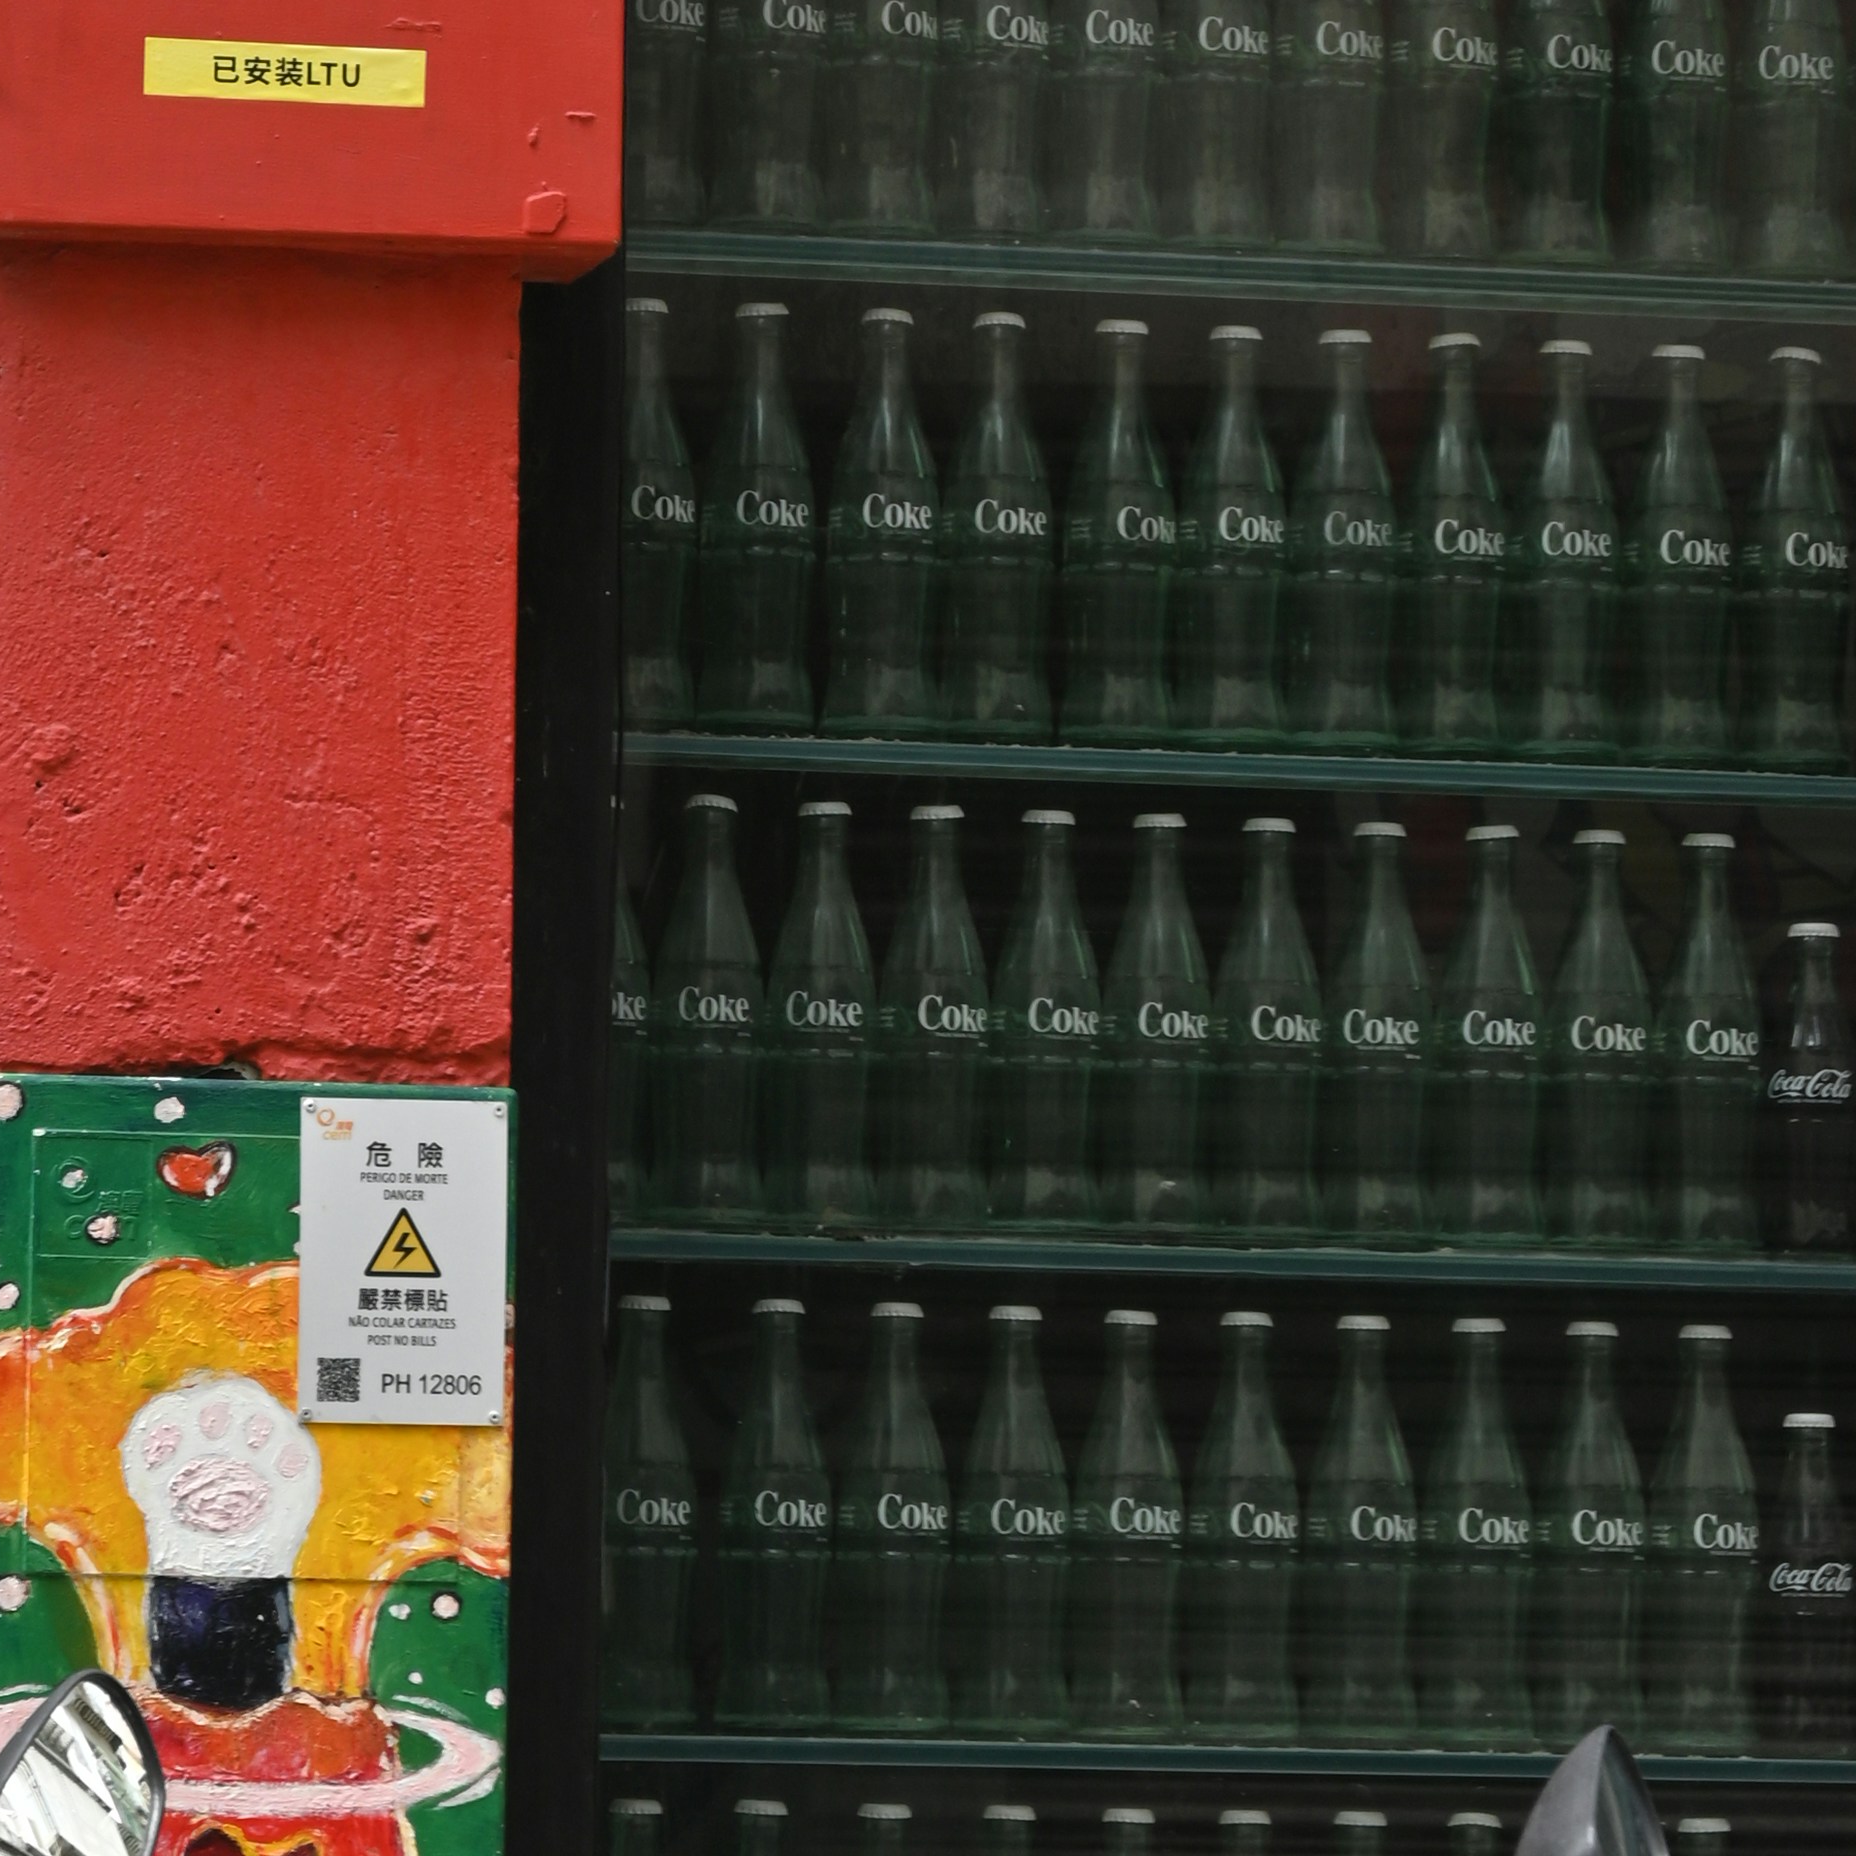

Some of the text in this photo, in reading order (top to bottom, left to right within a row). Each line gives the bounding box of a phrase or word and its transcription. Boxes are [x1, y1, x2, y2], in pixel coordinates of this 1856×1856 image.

[986, 5, 1048, 46] Coke
[1086, 9, 1153, 46] Coke
[1199, 16, 1269, 54] Coke
[1316, 21, 1384, 59] Coke
[213, 56, 361, 87] 已安装LTU
[1652, 40, 1725, 75] Coke
[1758, 45, 1834, 80] Coke
[736, 490, 808, 526] Coke
[862, 493, 932, 529] Coke
[975, 499, 1047, 535] Coke
[1218, 506, 1284, 543] Coke
[1324, 511, 1392, 546] Coke
[1434, 519, 1504, 556] Coke
[1541, 521, 1611, 556] Coke
[1660, 529, 1730, 566] Coke
[679, 986, 750, 1024] Coke
[787, 990, 863, 1026] Coke
[918, 995, 987, 1032] Coke
[1029, 998, 1099, 1035] Coke
[1138, 1002, 1208, 1039] Coke
[1251, 1005, 1321, 1042] Coke
[1343, 1009, 1420, 1044] Coke
[1462, 1010, 1536, 1045] Coke
[1570, 1015, 1645, 1052] Coke
[1686, 1020, 1759, 1056] Coke
[1767, 1069, 1852, 1098] Coca-Cola
[360, 1172, 448, 1184] PERIGO DE MORTE
[383, 1189, 424, 1201] DANGER
[358, 1288, 448, 1312] 嚴禁標貼
[348, 1315, 456, 1329] NÃO COLAR CARTAZES
[367, 1335, 437, 1346] POST NO BILLS
[381, 1373, 482, 1395] PH 12806
[617, 1489, 691, 1525] Coke
[754, 1490, 827, 1527] Coke
[877, 1493, 948, 1530] Coke
[991, 1499, 1065, 1535] Coke
[1110, 1497, 1181, 1534] Coke
[1230, 1502, 1299, 1539] Coke
[1458, 1508, 1528, 1544] Coke
[1572, 1510, 1643, 1546] Coke
[1694, 1513, 1759, 1550] Coke
[1769, 1562, 1853, 1592] Coca-Cola
